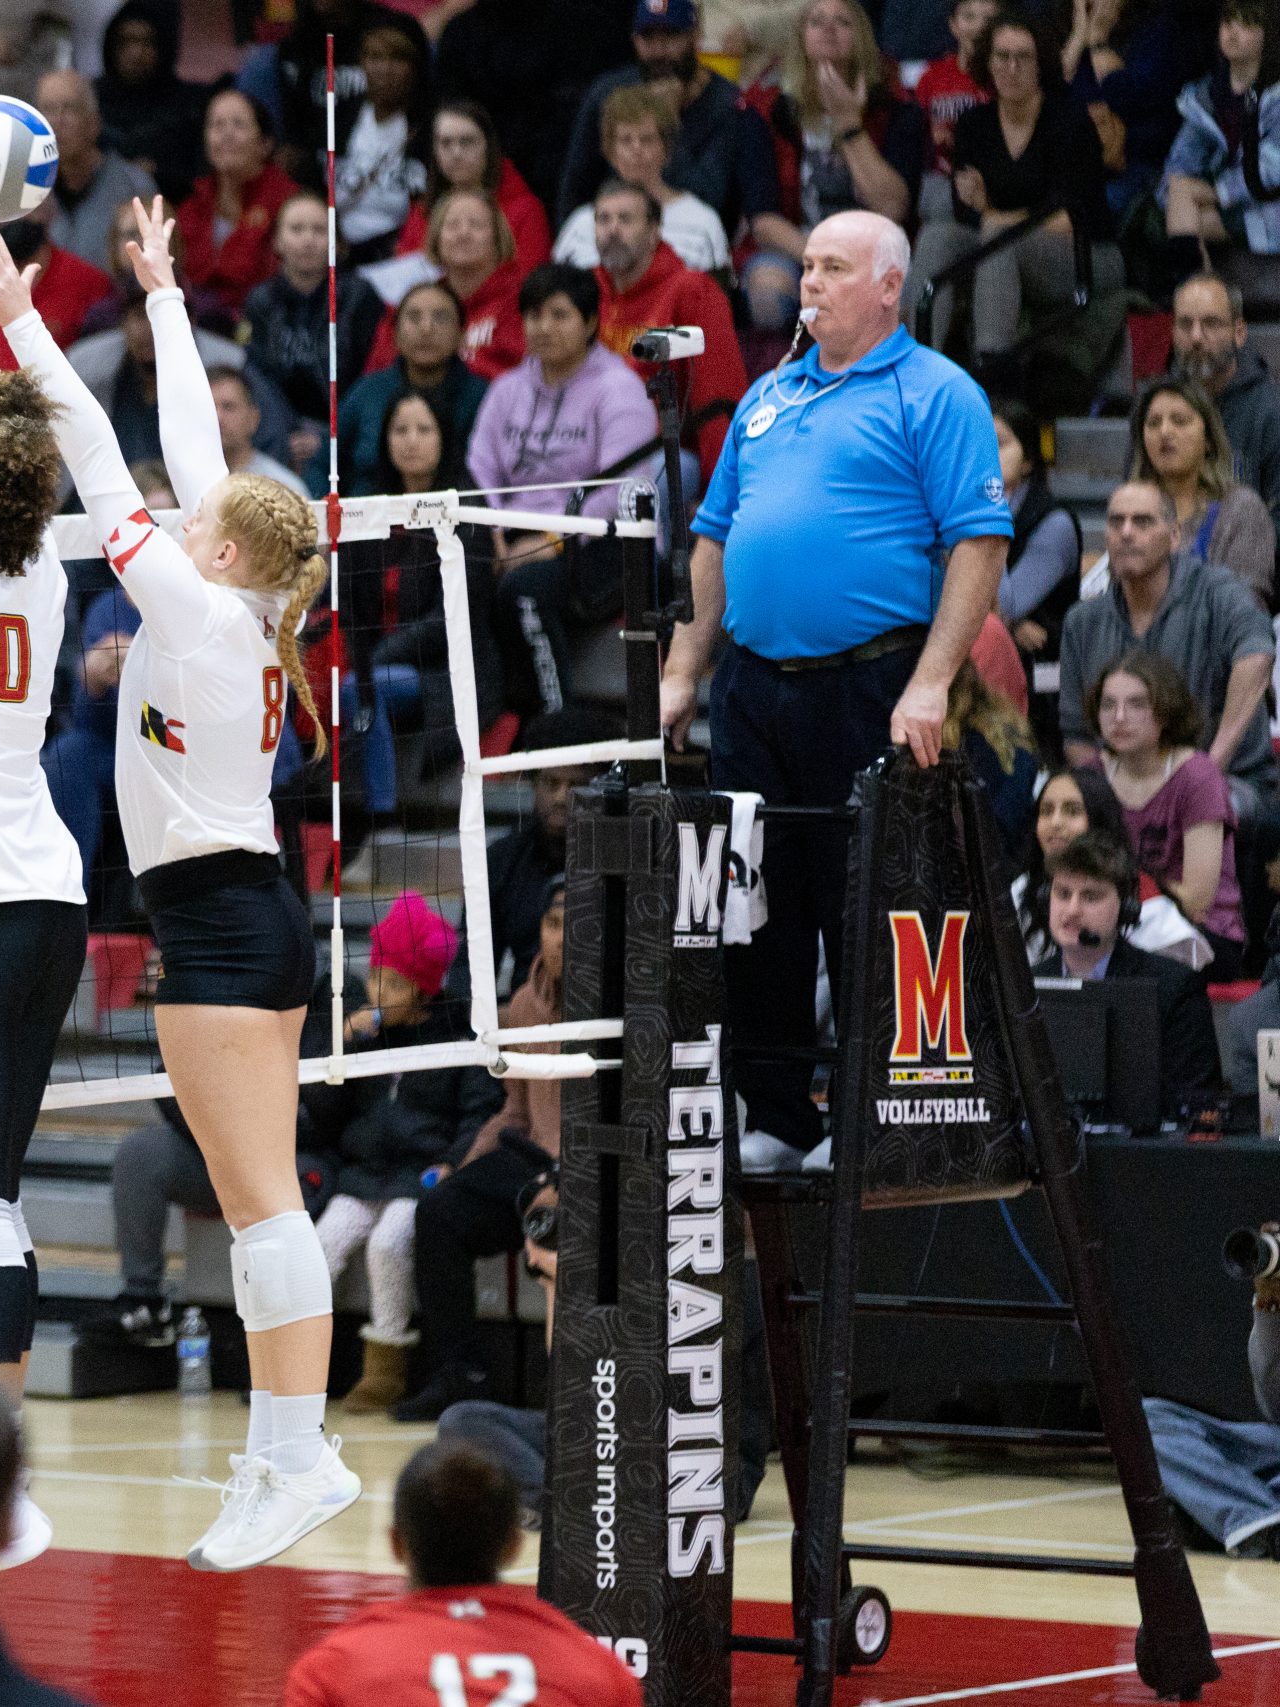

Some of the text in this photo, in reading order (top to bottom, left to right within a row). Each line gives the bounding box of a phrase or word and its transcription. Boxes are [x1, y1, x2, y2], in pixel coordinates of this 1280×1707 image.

[261, 666, 284, 753] 8
[674, 822, 728, 932] M
[888, 910, 973, 1062] M
[876, 1098, 991, 1125] VOLLEYBALL
[667, 1023, 725, 1579] TERRAPINS
[592, 1358, 619, 1590] sports imports
